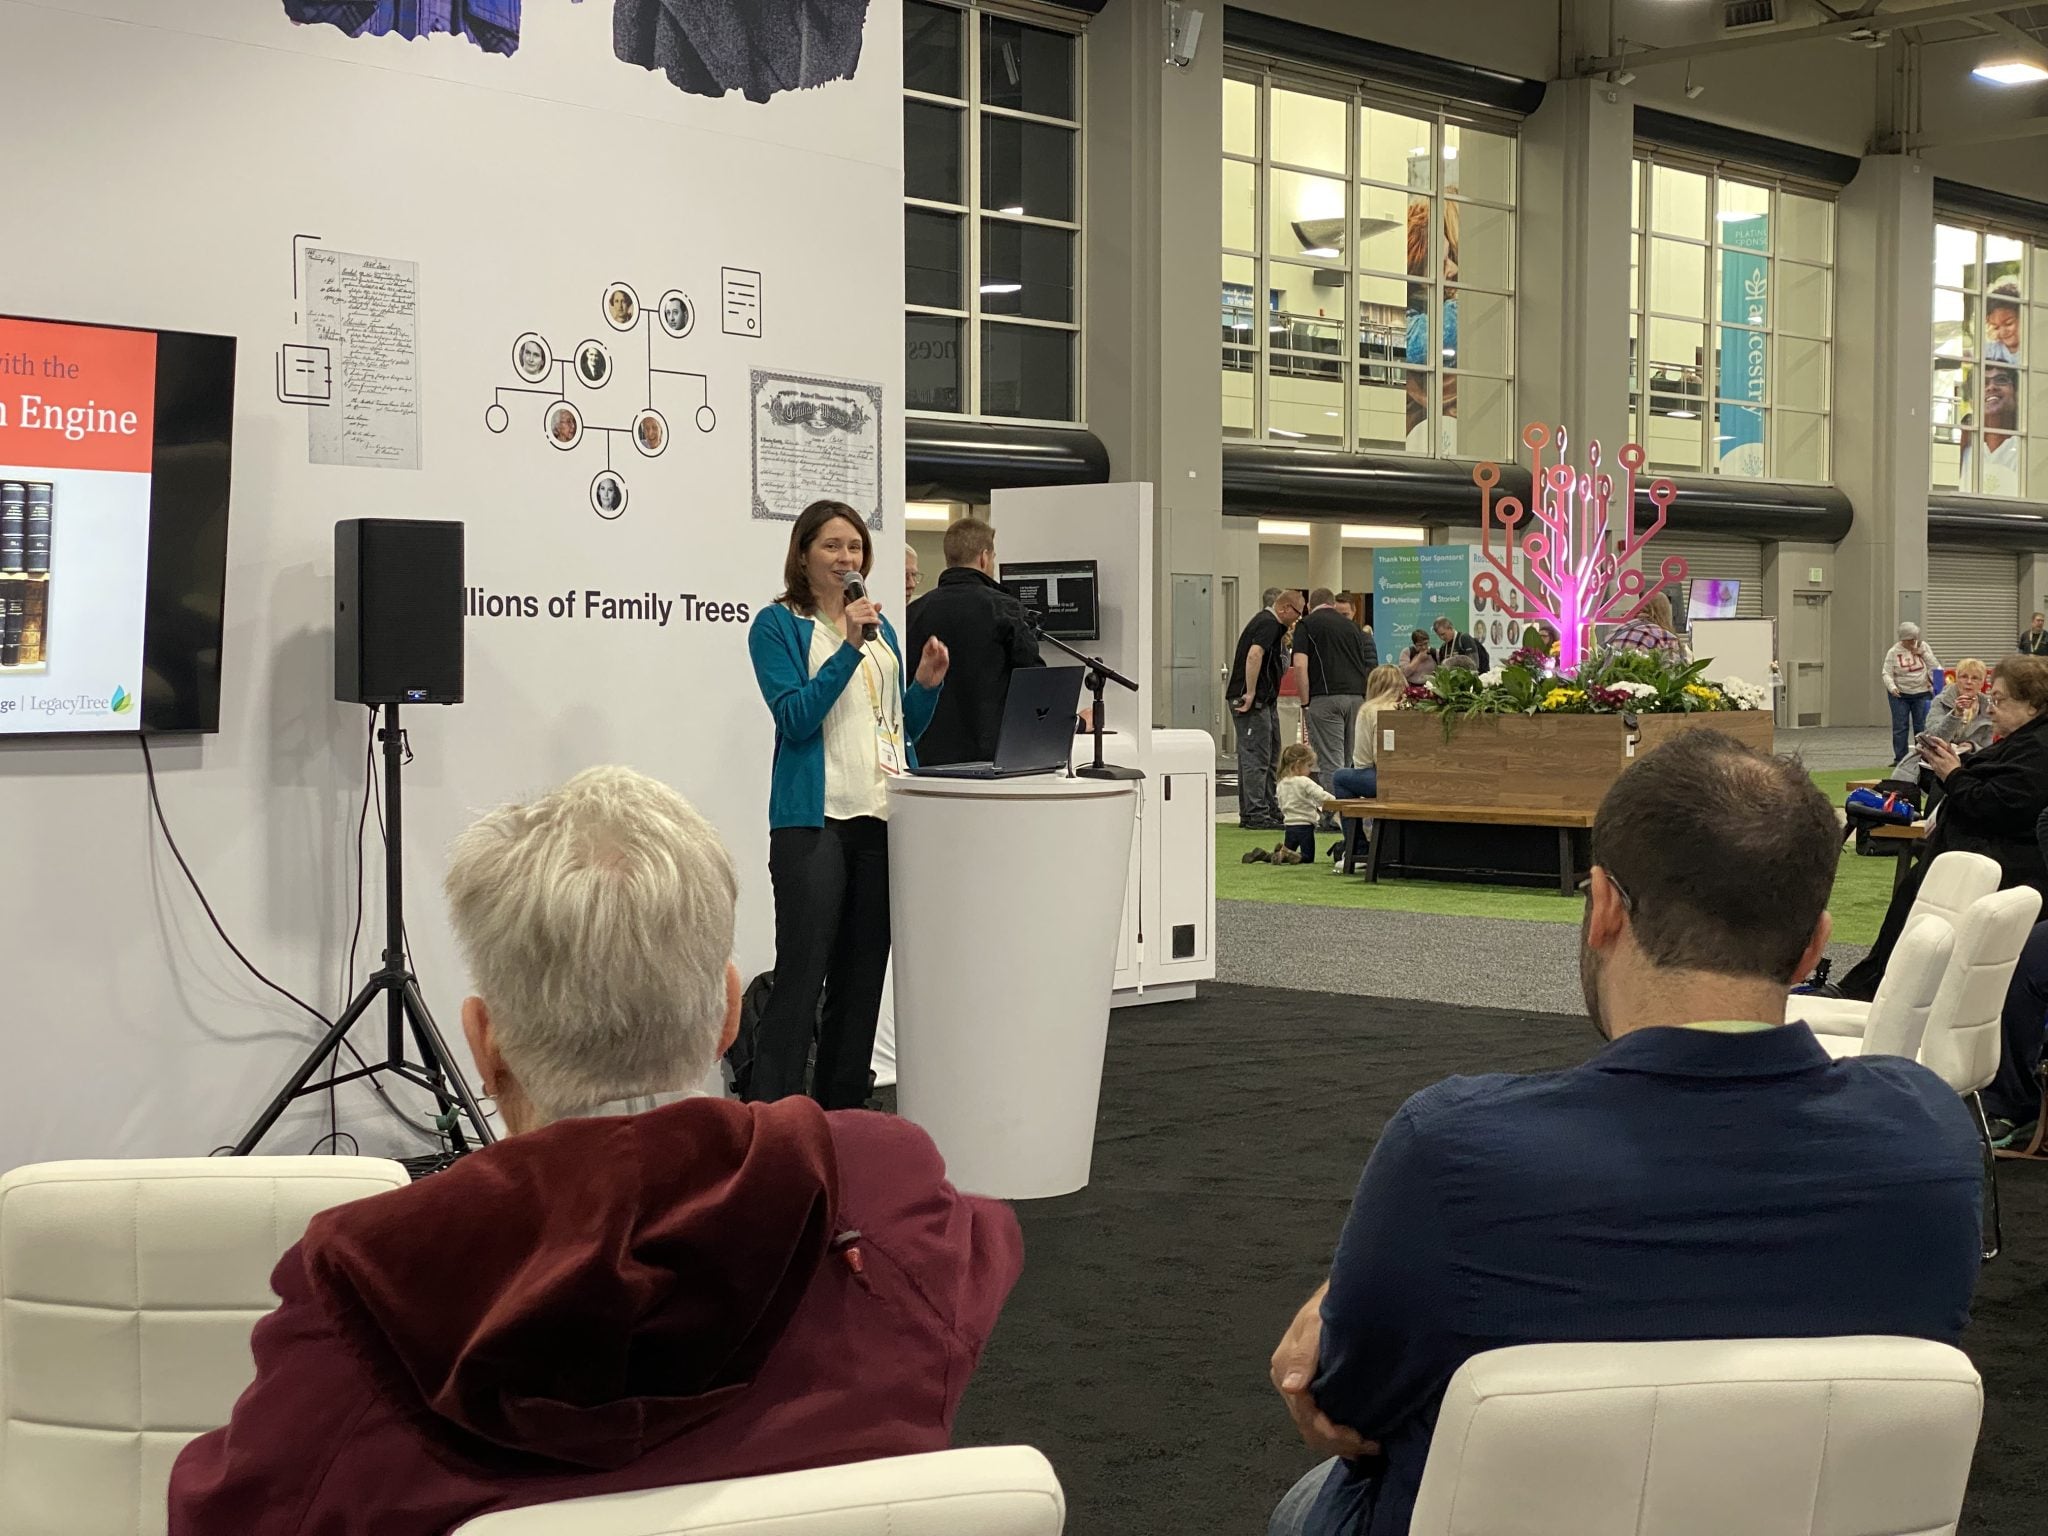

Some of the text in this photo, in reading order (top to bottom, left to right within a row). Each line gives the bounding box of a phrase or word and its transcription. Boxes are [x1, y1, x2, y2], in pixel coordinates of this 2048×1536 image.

[1735, 237, 1767, 248] SPONS
[0, 353, 80, 379] ith the
[20, 394, 138, 441] Engine
[1379, 555, 1398, 563] Thank
[1433, 554, 1464, 563] Sponsors!
[1435, 580, 1463, 589] ancestry
[549, 590, 576, 618] of
[585, 591, 672, 626] Family
[680, 594, 750, 623] Trees
[30, 695, 110, 716] LegacyTree
